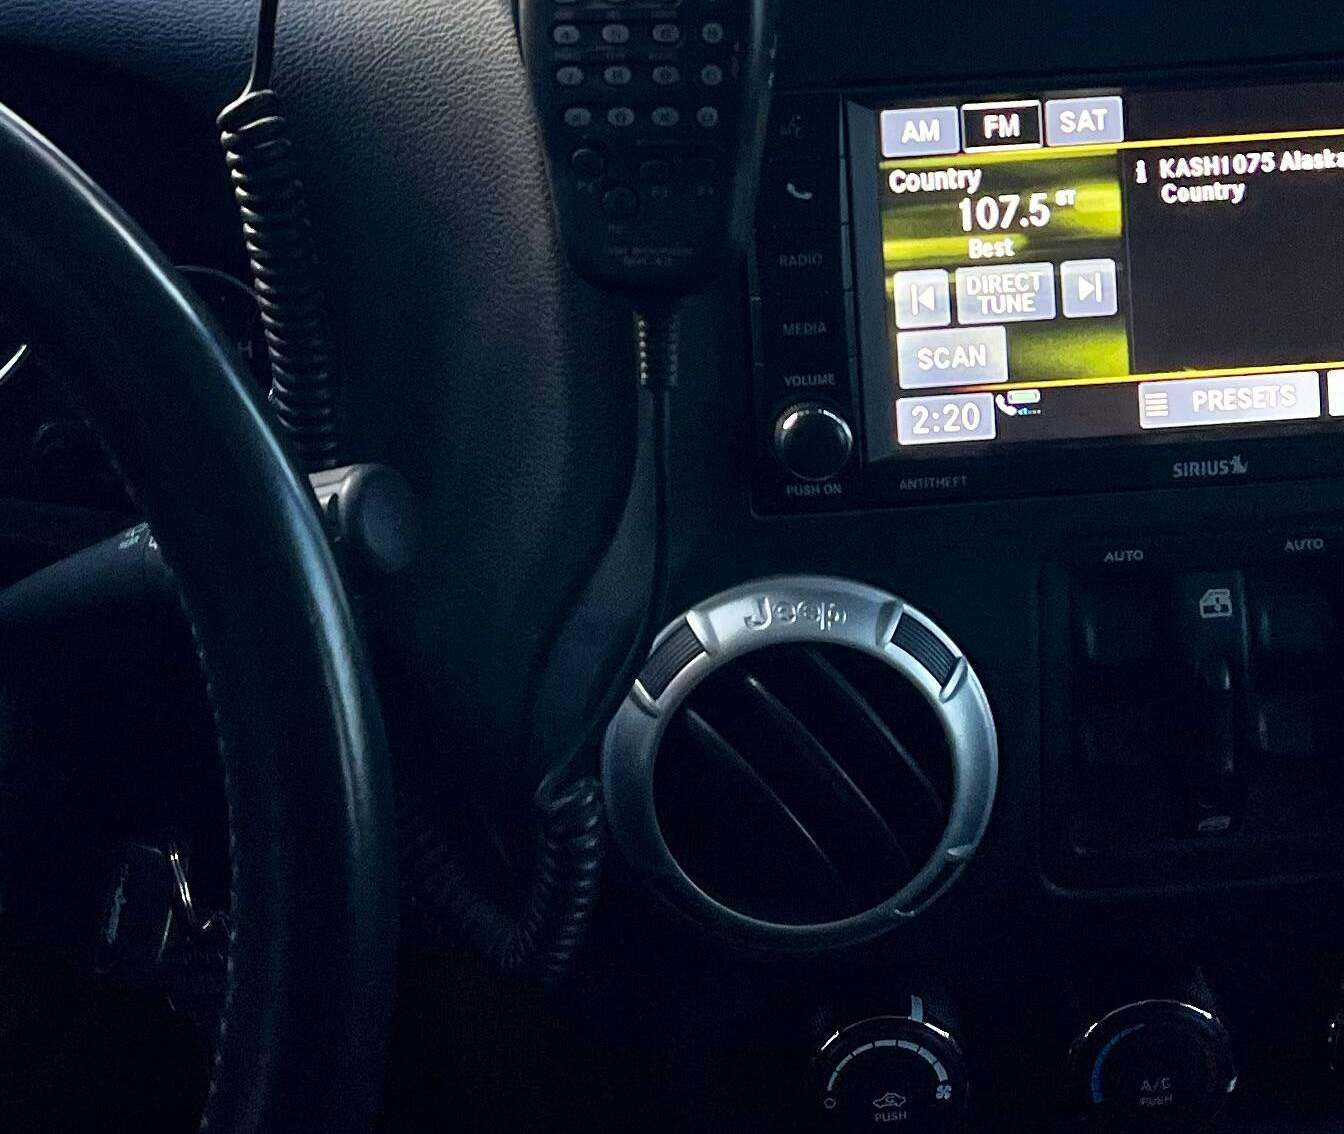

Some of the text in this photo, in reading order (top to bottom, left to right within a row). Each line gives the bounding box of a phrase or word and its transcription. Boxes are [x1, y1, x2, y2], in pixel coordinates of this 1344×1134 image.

[902, 119, 940, 144] AM
[983, 113, 1021, 139] FM
[1059, 108, 1108, 133] SAT
[1159, 151, 1276, 180] KASH1075
[888, 168, 982, 195] Country
[1160, 181, 1246, 204] Country
[958, 192, 1051, 233] 107.5
[778, 252, 824, 268] RADIO
[968, 237, 1016, 260] Best
[966, 271, 1044, 296] DIRECT
[976, 292, 1036, 315] TUNE
[782, 322, 828, 337] MEDIA
[917, 344, 987, 371] SCAN
[783, 373, 836, 387] VOLUME
[1192, 384, 1297, 413] PRESETS
[911, 402, 981, 435] 2:20
[1172, 458, 1229, 478] SIRIUS
[785, 482, 843, 498] PUSH ON
[1104, 549, 1145, 563] AUTO
[1283, 537, 1325, 553] AUTO
[743, 595, 848, 632] Jeep
[874, 1110, 908, 1123] PUSH
